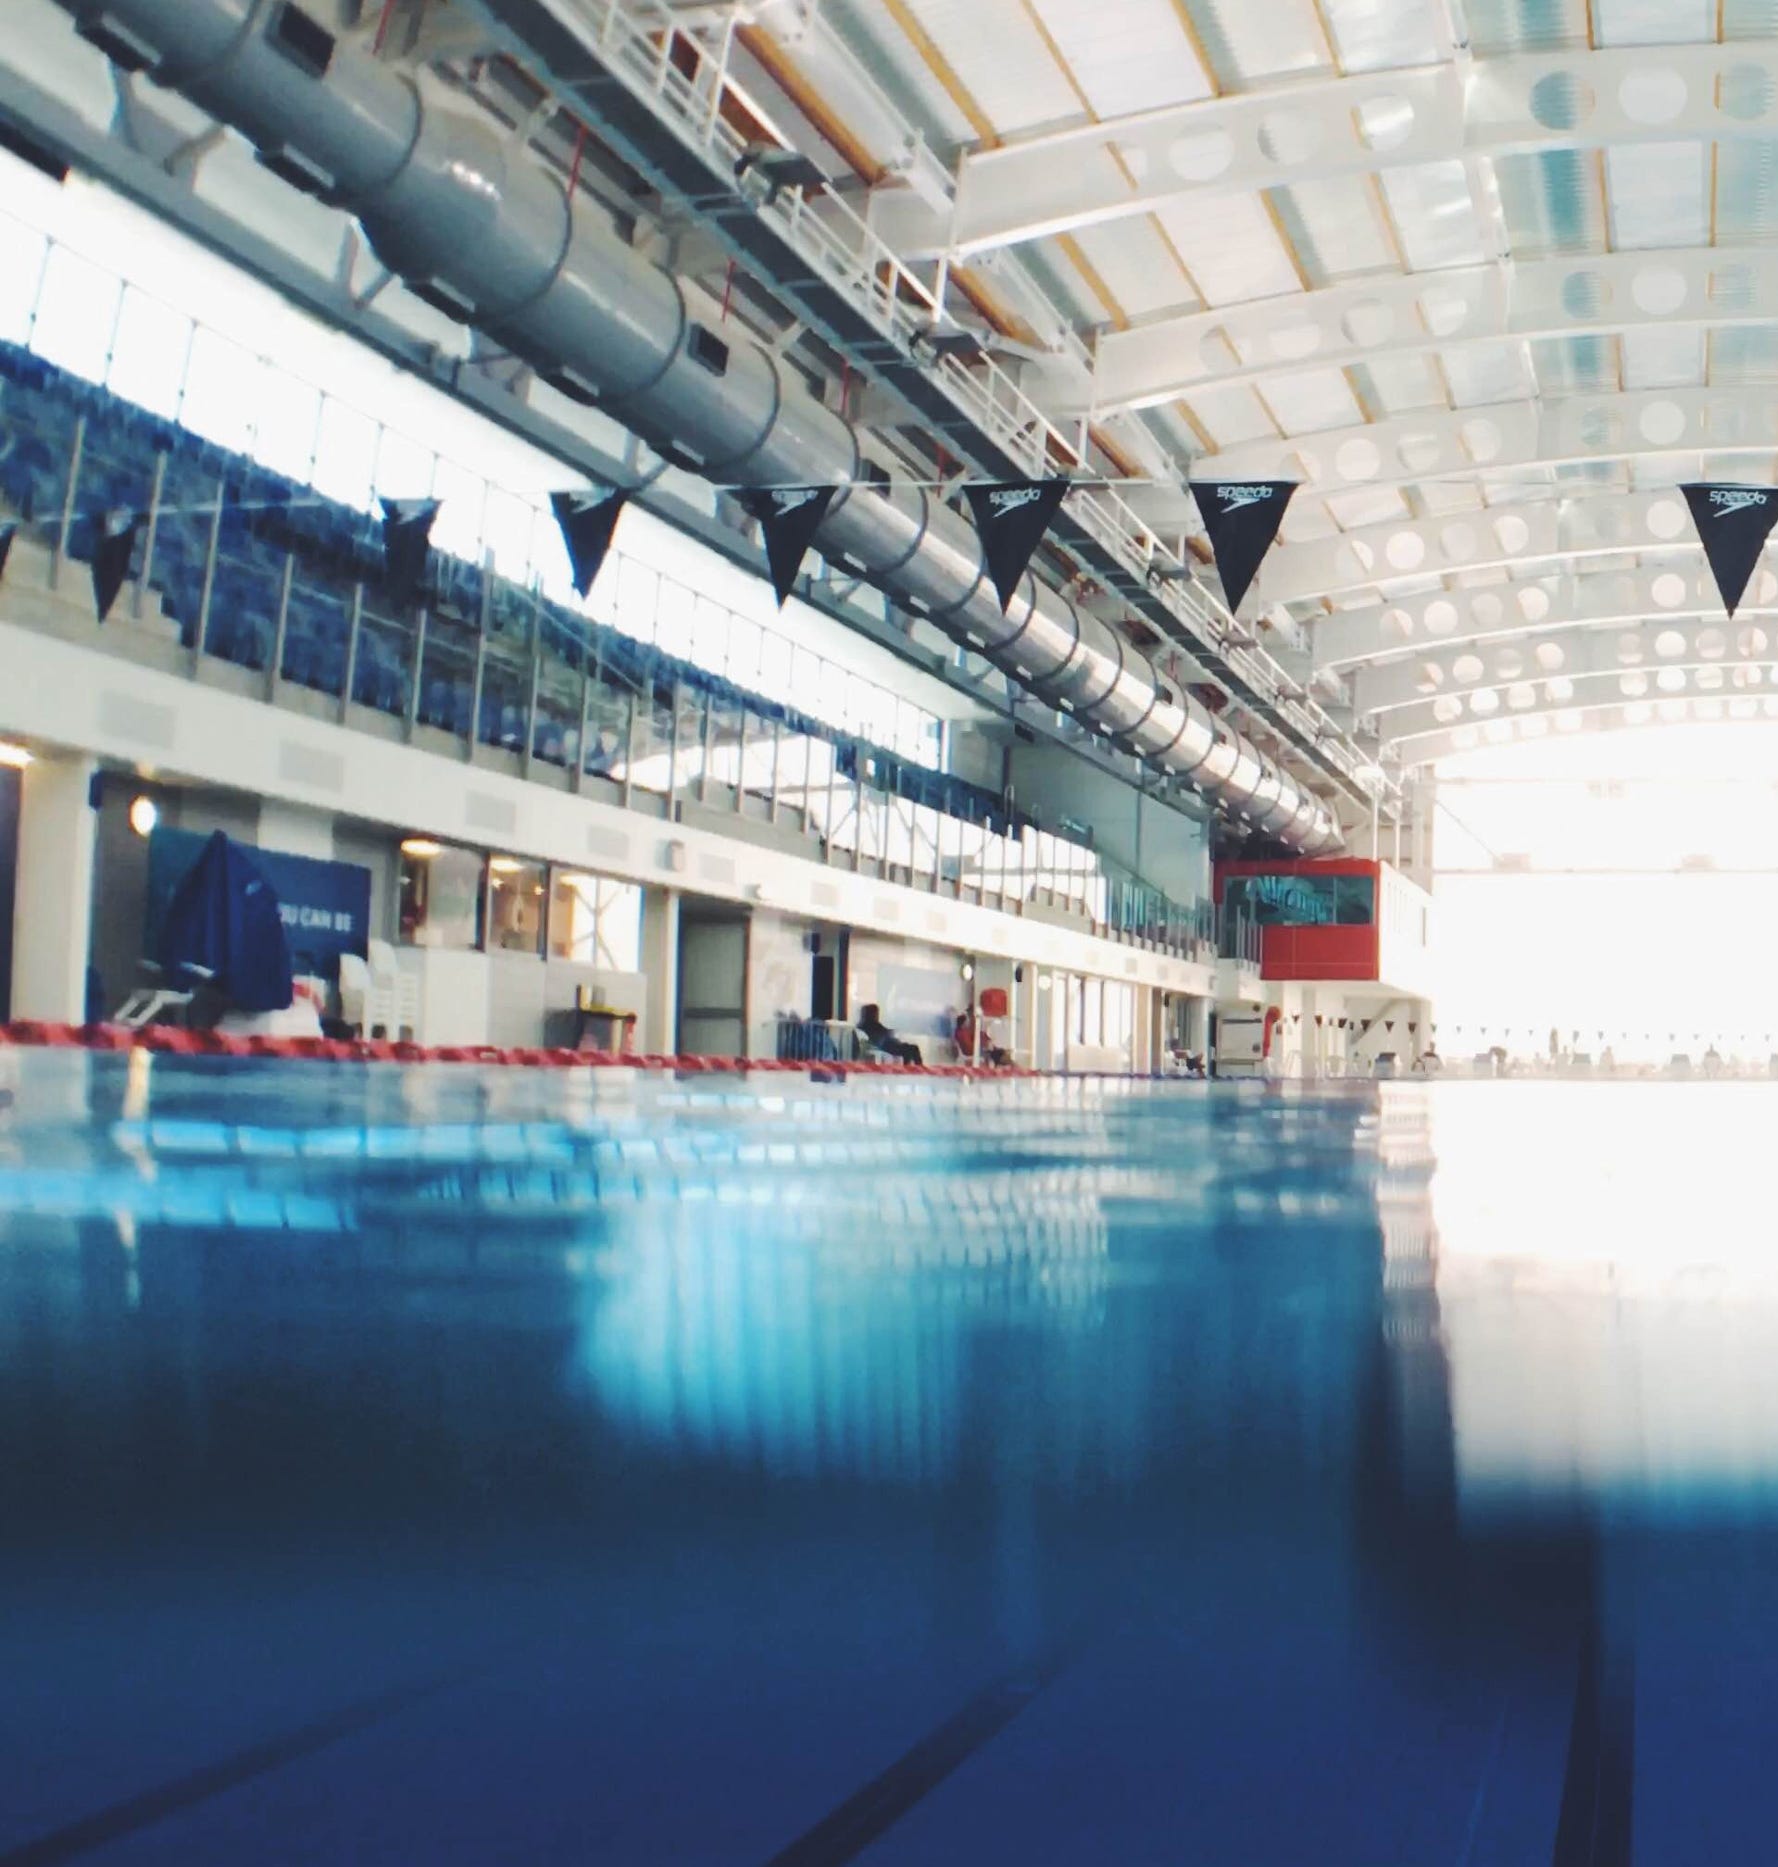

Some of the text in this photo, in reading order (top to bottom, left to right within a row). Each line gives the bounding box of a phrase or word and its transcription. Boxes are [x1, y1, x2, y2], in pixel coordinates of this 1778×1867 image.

[1216, 485, 1273, 500] speedo
[1709, 490, 1767, 505] speedo
[300, 905, 332, 929] CAN
